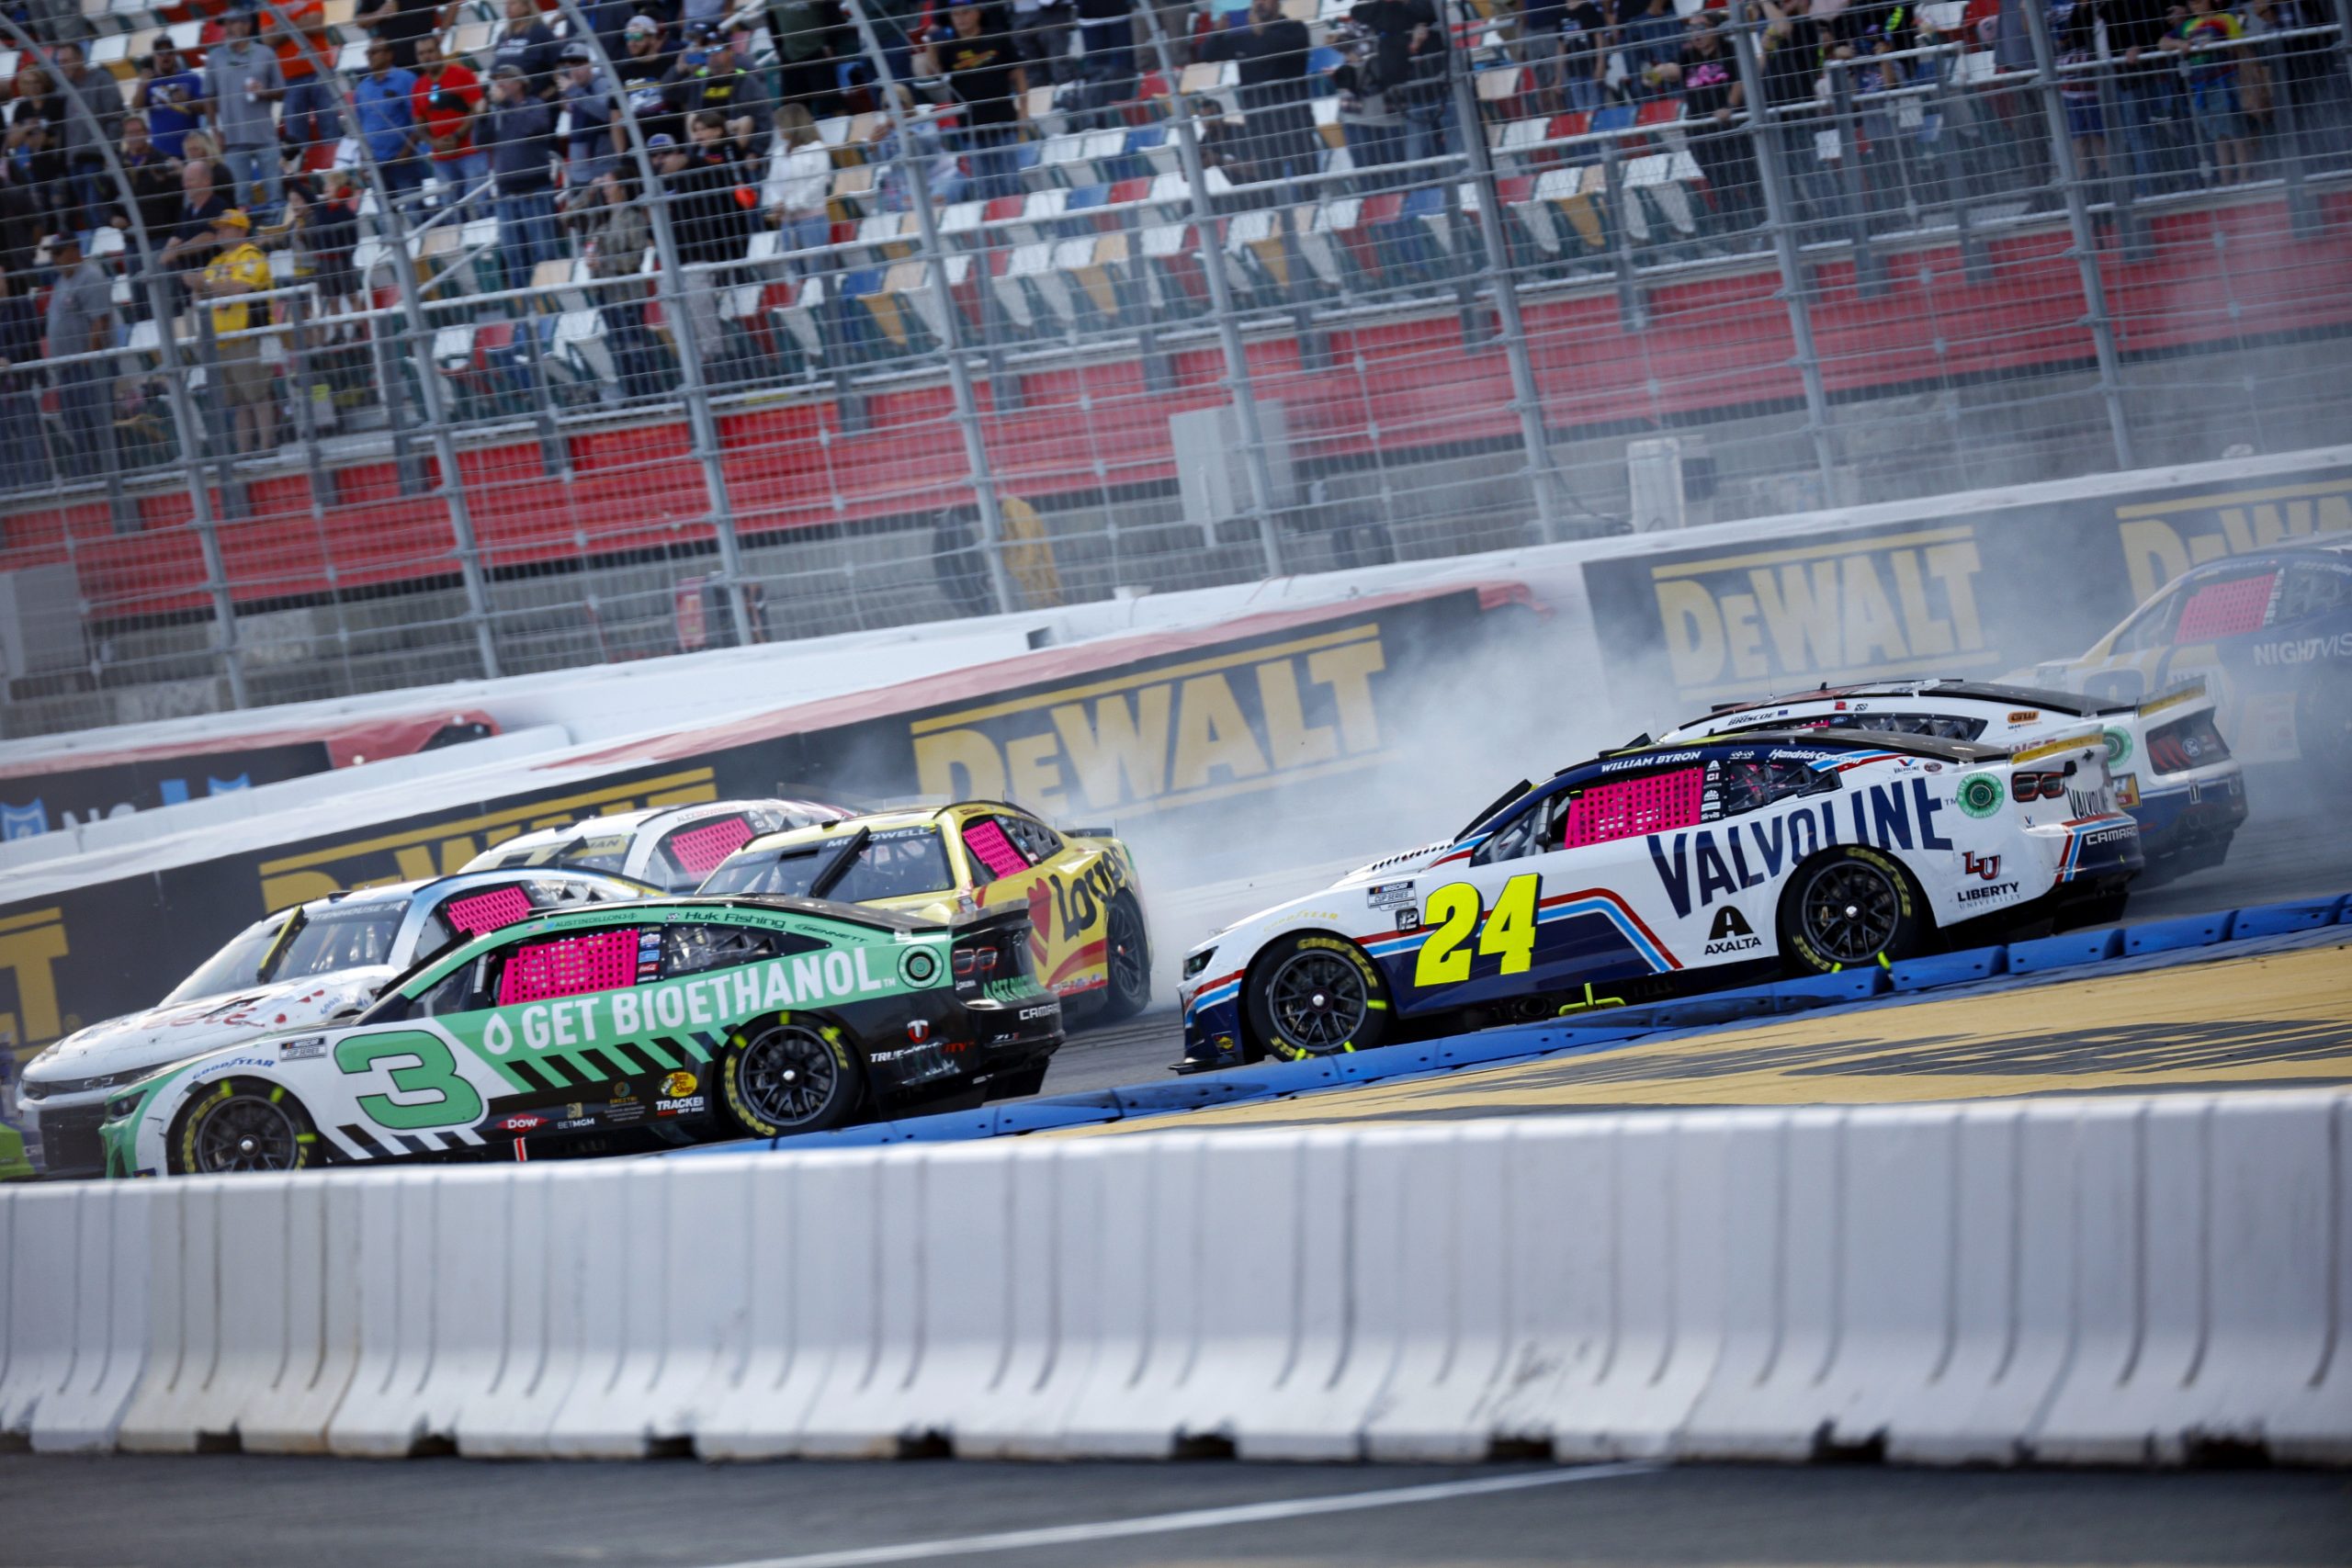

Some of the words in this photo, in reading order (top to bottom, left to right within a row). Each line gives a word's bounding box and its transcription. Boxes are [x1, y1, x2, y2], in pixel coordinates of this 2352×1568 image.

[1655, 540, 1982, 689] DEWALT
[913, 641, 1385, 818] DEWALT
[1727, 711, 1774, 726] BRISCOE
[1601, 757, 1655, 773] WILLIAM
[1655, 750, 1702, 764] BYRON
[1646, 776, 1953, 919] VALVOLINE
[1957, 881, 2020, 902] LIBERTY
[1959, 894, 2021, 910] UNIVERSITY
[684, 911, 718, 922] Huk
[724, 913, 786, 930] Fishing
[1414, 872, 1542, 987] 24
[802, 925, 869, 943] BENNETT
[1704, 937, 1762, 955] AXALTA
[521, 998, 600, 1050] GET
[611, 947, 882, 1036] BIOETHANOL
[193, 1056, 276, 1080] GOODYEAR
[333, 1029, 488, 1130] 3
[557, 1117, 595, 1130] BETMGM
